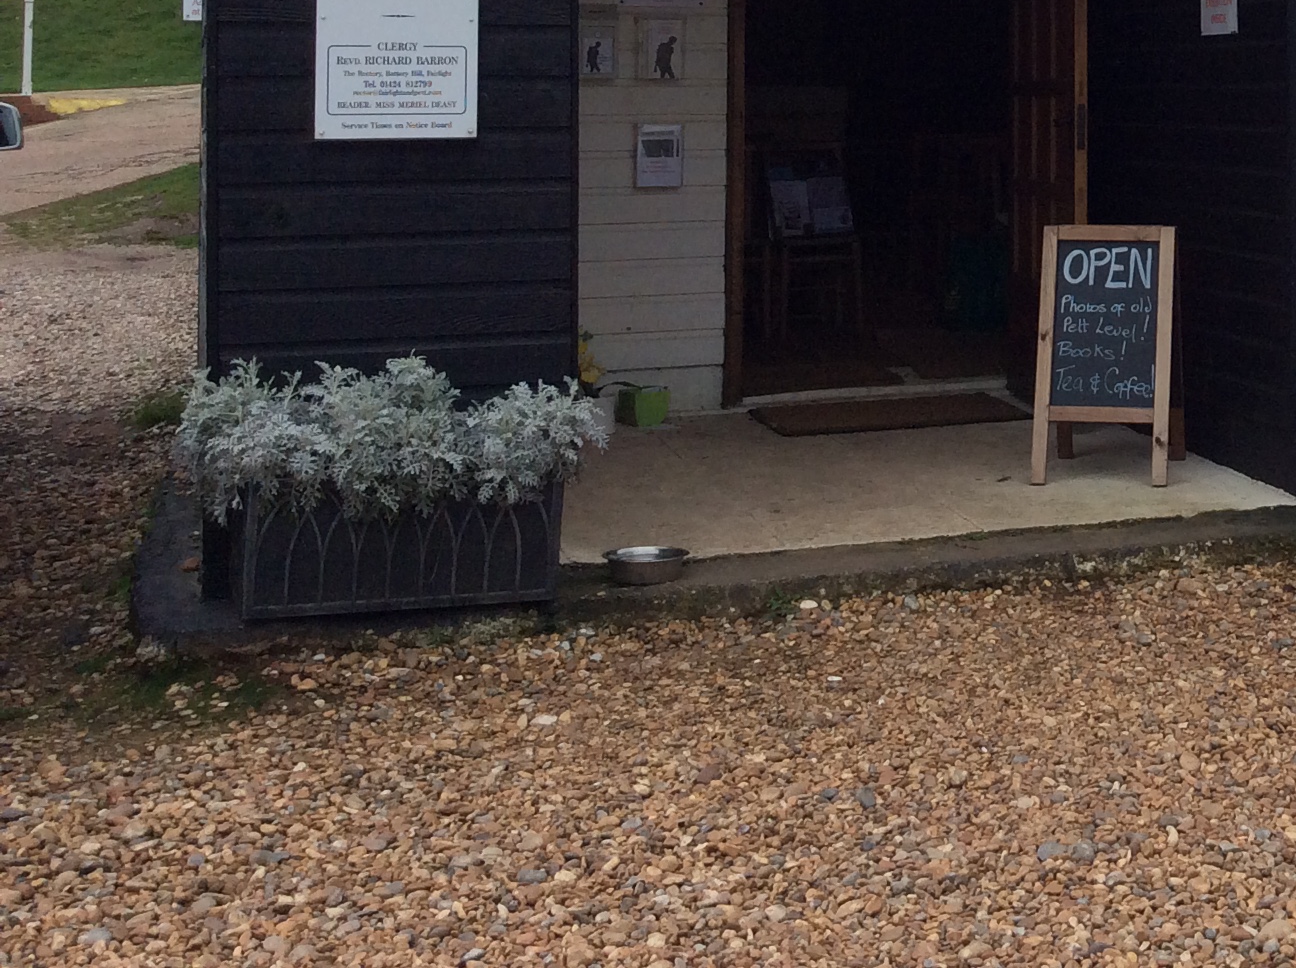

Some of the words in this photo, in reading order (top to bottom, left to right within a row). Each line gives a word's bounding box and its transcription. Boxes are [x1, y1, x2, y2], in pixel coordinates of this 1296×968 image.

[377, 42, 418, 52] CLERGY
[364, 56, 412, 65] RICHARD
[416, 56, 459, 65] BARRON
[1062, 246, 1153, 289] OPEN
[1060, 294, 1107, 314] Photos
[1110, 302, 1126, 317] of
[1130, 295, 1153, 313] old
[1063, 316, 1090, 333] Pett
[1055, 364, 1083, 392] Tea
[1090, 374, 1101, 394] &
